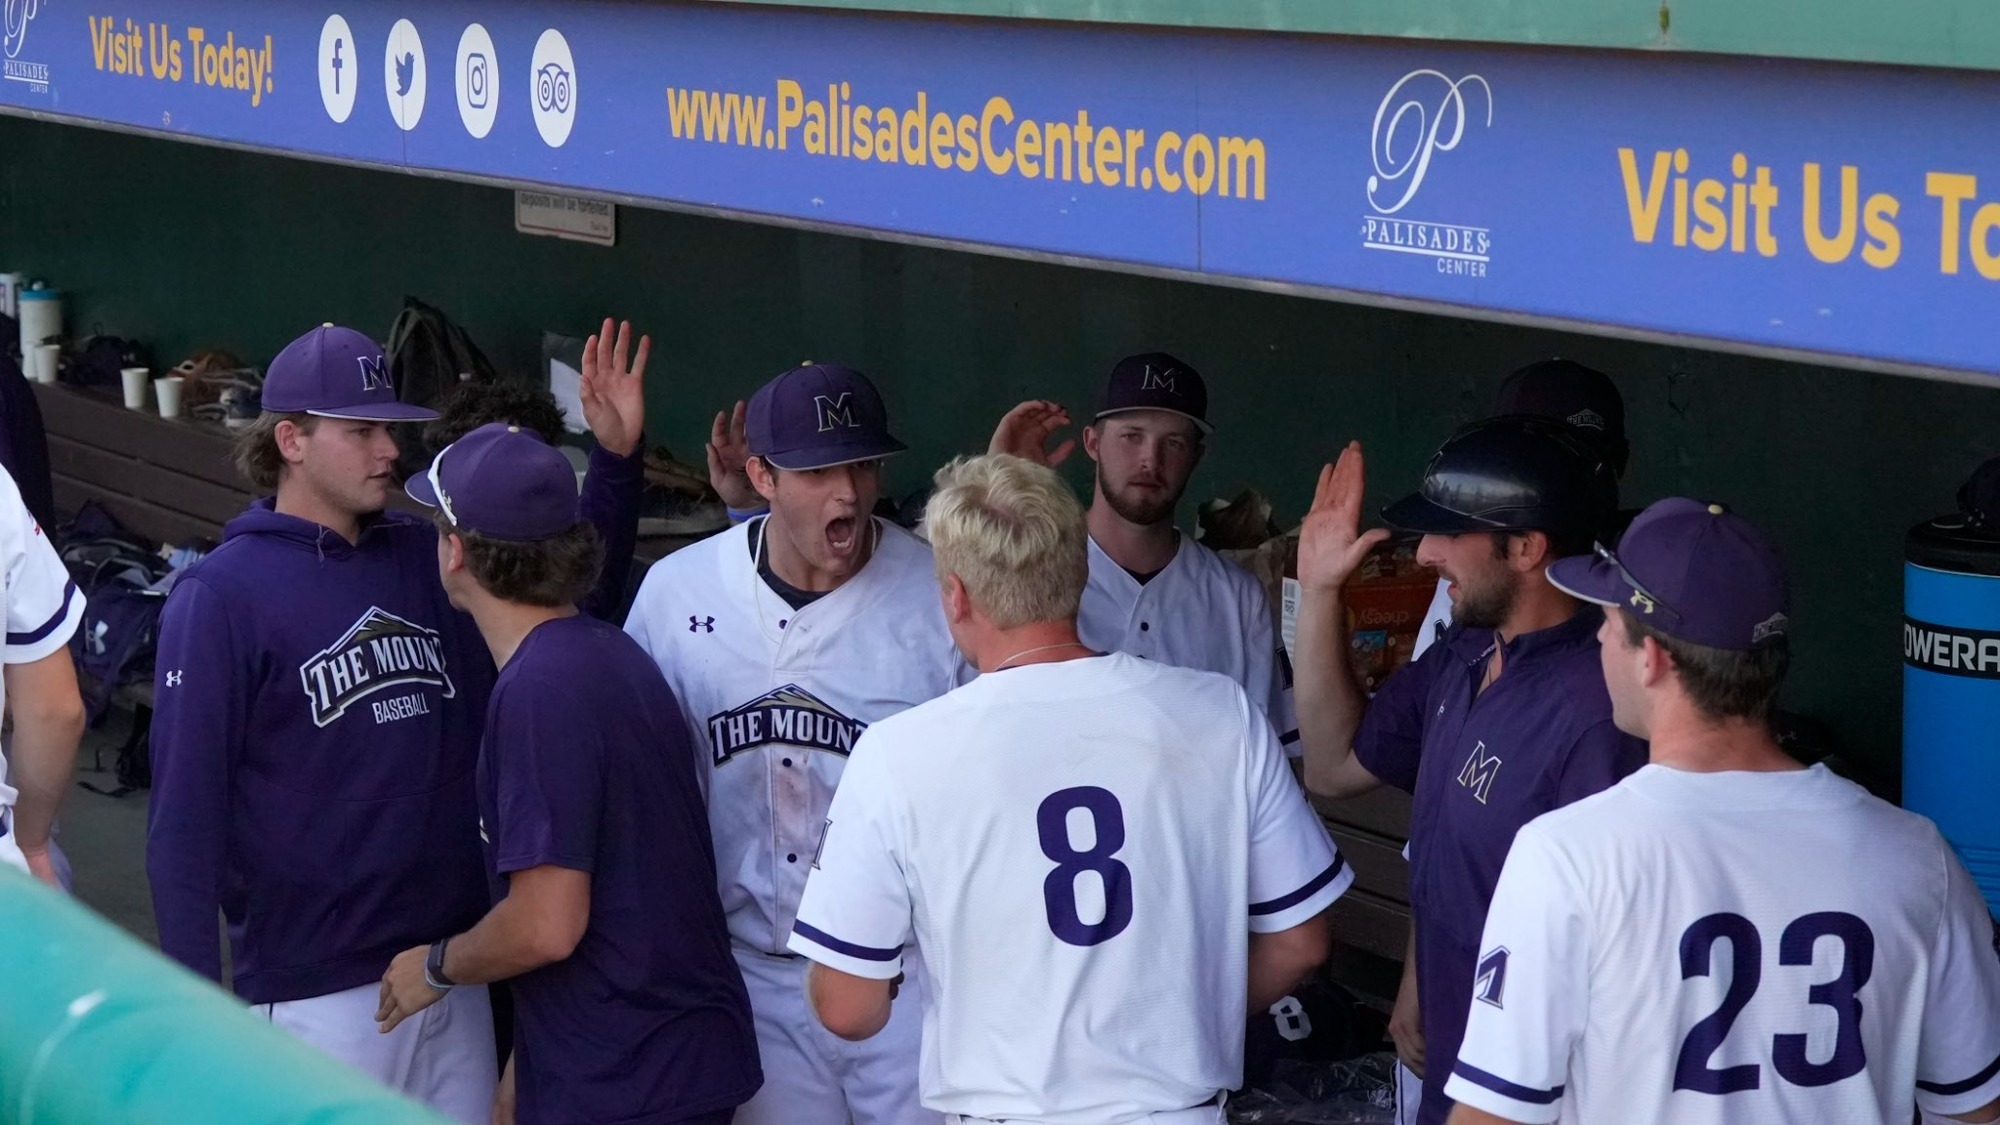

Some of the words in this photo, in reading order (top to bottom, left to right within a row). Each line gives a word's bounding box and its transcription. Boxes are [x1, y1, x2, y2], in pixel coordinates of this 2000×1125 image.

[5, 61, 48, 80] PALISADES
[89, 16, 144, 76] Visit
[149, 23, 183, 82] Us
[187, 26, 272, 107] Today!
[30, 83, 48, 94] CENTER
[667, 79, 1266, 200] www.PalisadesCenter.com
[1618, 147, 1779, 257] Visit
[1803, 162, 1902, 269] Us
[1367, 219, 1488, 254] PALISADES
[1437, 257, 1486, 277] CENTER
[356, 354, 392, 391] M
[813, 392, 861, 432] M
[310, 645, 370, 711] THE
[372, 692, 430, 724] BASEBALL
[711, 710, 763, 759] THE
[770, 708, 868, 752] MOUN
[1457, 740, 1502, 805] M
[1036, 785, 1133, 947] 8
[1269, 995, 1312, 1041] 8
[1672, 911, 1875, 1095] 23
